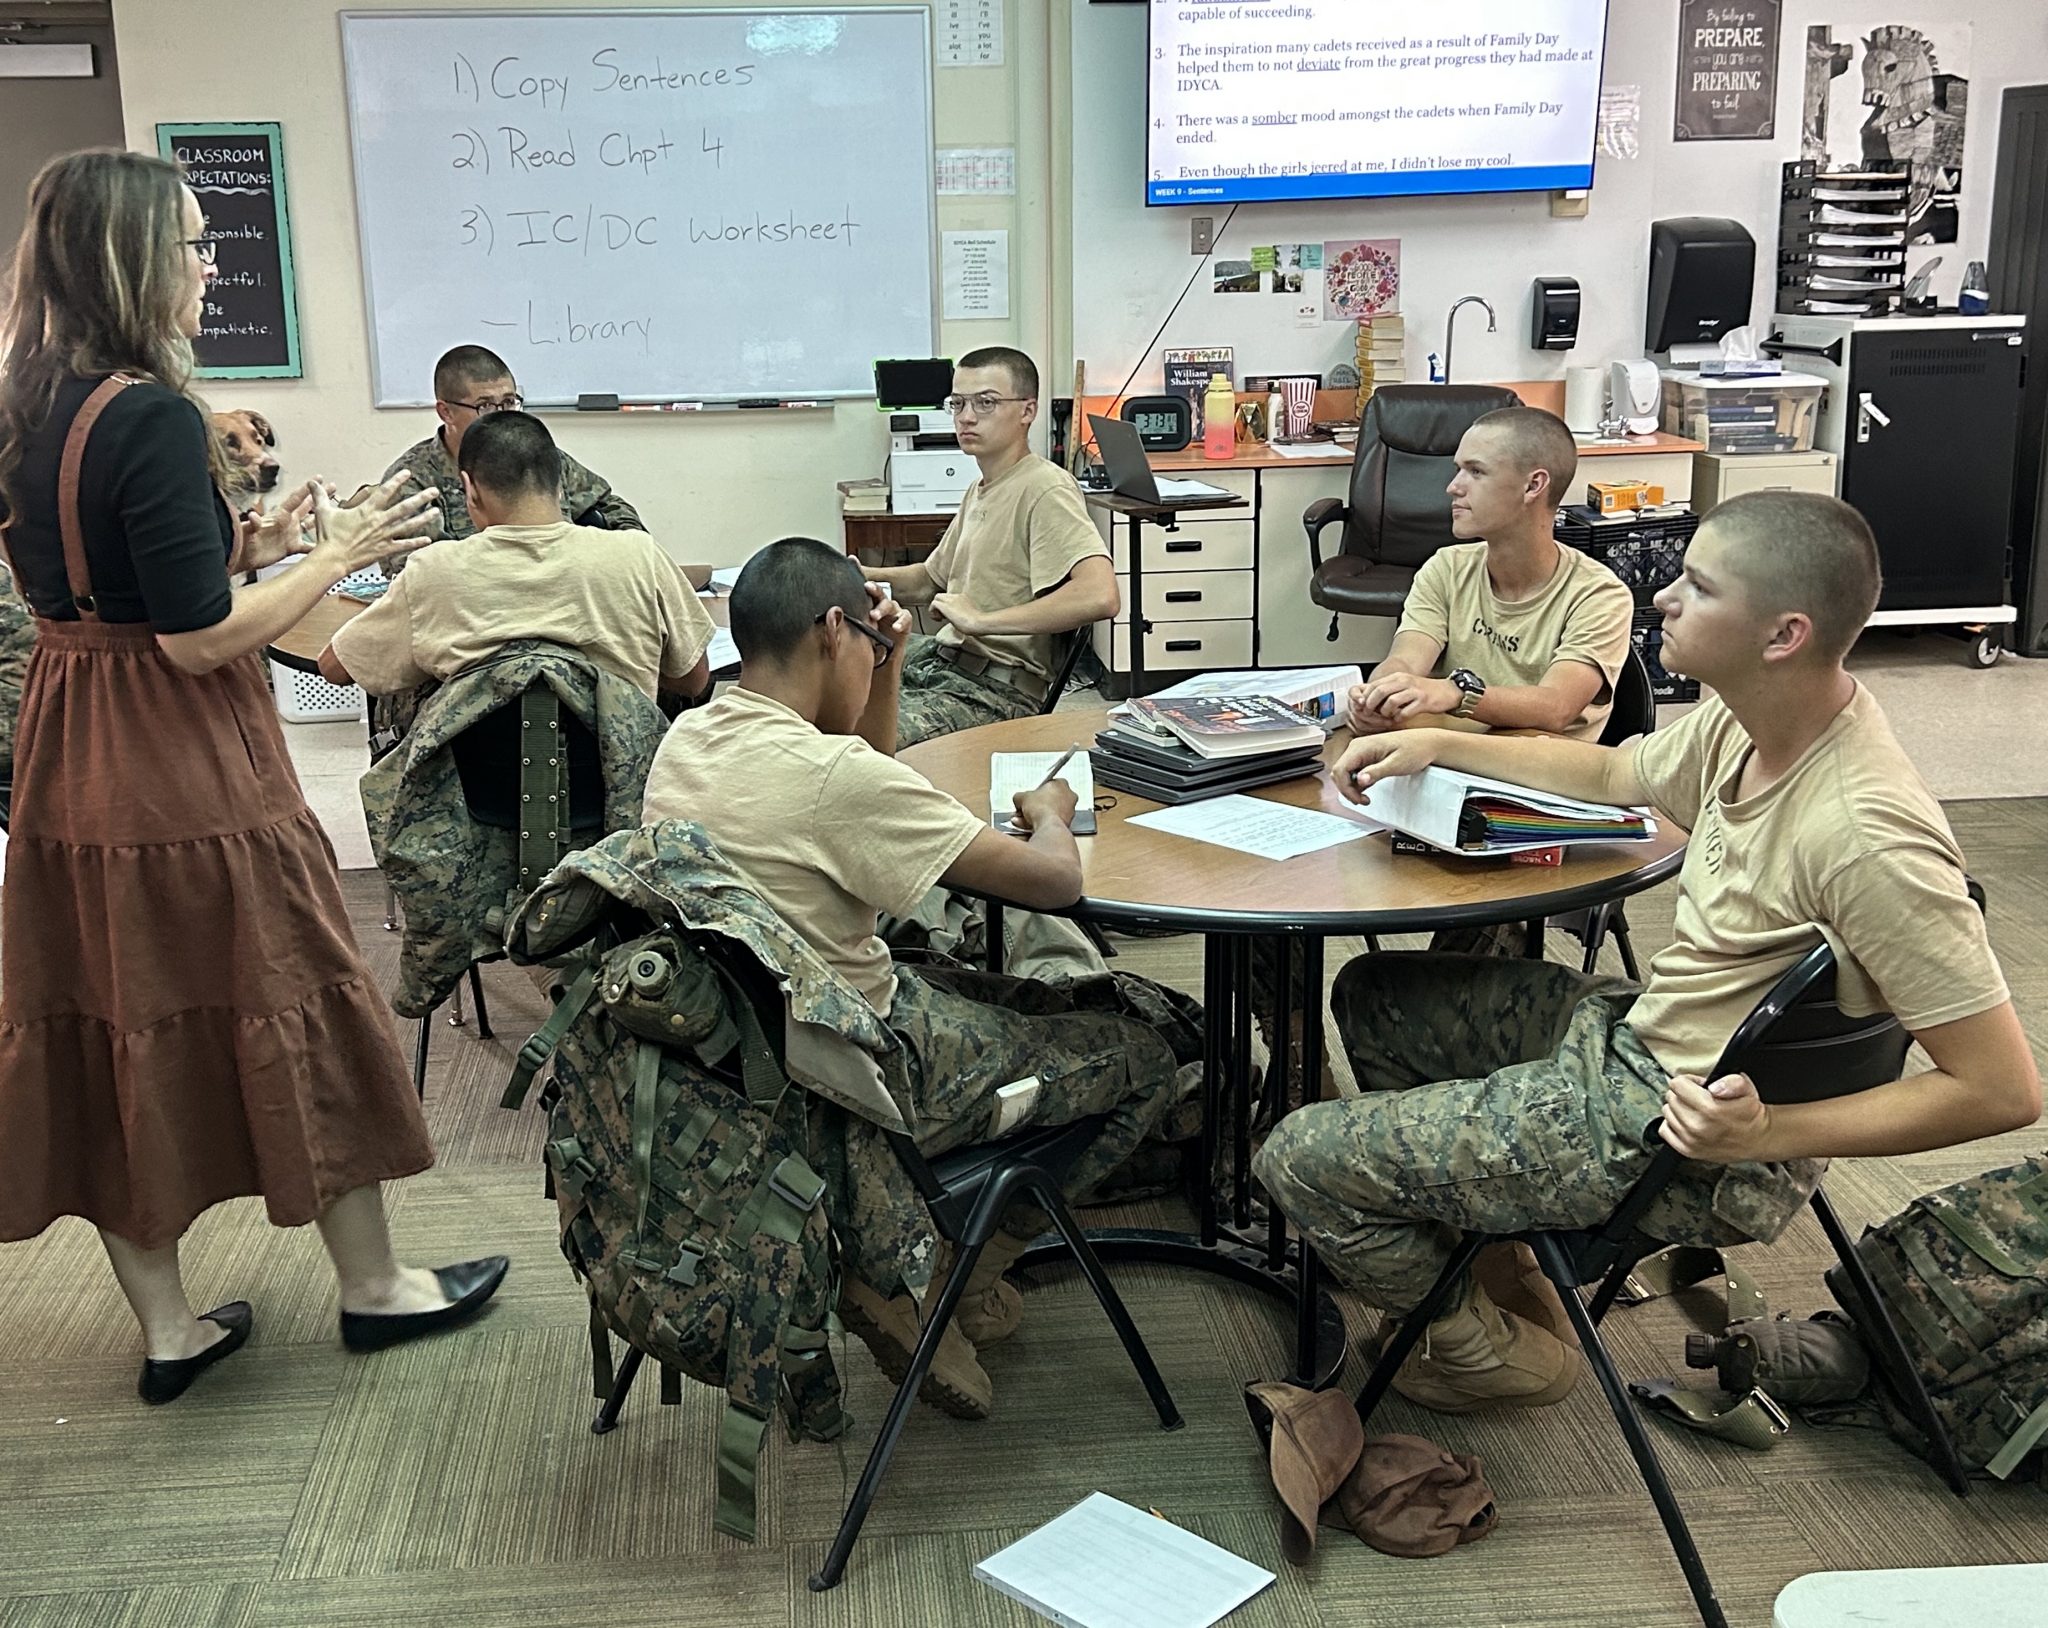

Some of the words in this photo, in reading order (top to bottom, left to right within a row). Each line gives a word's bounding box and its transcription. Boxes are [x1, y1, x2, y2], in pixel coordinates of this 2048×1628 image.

[1178, 8, 1226, 24] capable
[1229, 7, 1242, 19] of
[1244, 6, 1315, 20] succeeding.
[1706, 8, 1719, 26] By
[1747, 12, 1756, 21] to
[1154, 48, 1166, 60] 3.
[1178, 44, 1201, 57] The
[1205, 43, 1273, 60] inspiration
[1276, 42, 1310, 56] many
[1314, 38, 1352, 53] cadets
[1356, 36, 1406, 51] received
[1410, 39, 1423, 49] as
[1426, 39, 1433, 48] a
[1436, 34, 1470, 48] result
[1474, 34, 1488, 46] of
[1490, 32, 1532, 48] Family
[1535, 33, 1560, 46] Day
[1695, 27, 1766, 48] PREPARE,
[1178, 60, 1219, 76] helped
[1222, 60, 1254, 73] them
[1258, 60, 1270, 72] to
[1274, 59, 1293, 71] not
[1297, 56, 1341, 72] deviate
[1344, 56, 1374, 69] from
[1378, 54, 1397, 67] the
[1400, 54, 1430, 70] great
[1434, 54, 1486, 69] progress
[1490, 51, 1516, 65] they
[1519, 49, 1542, 63] had
[1545, 48, 1578, 62] made
[1581, 50, 1594, 61] at
[1712, 53, 1727, 70] you
[1729, 52, 1744, 65] are
[492, 56, 568, 112] Copy
[592, 48, 756, 92] Sentences
[1178, 80, 1222, 92] IDYCA.
[1692, 70, 1762, 92] PREPARING
[1711, 97, 1722, 109] to
[1154, 118, 1165, 130] 4.
[1176, 114, 1212, 127] There
[1215, 116, 1239, 126] was
[1242, 116, 1248, 125] a
[1252, 111, 1298, 125] somber
[1301, 109, 1335, 122] mood
[1338, 108, 1390, 123] amongst
[1394, 106, 1414, 119] the
[1417, 104, 1455, 118] cadets
[1458, 104, 1490, 116] when
[1494, 102, 1536, 118] Family
[1539, 102, 1564, 116] Day
[1176, 130, 1216, 144] ended.
[176, 147, 264, 164] CLASSROOM
[498, 126, 576, 173] Read
[600, 128, 674, 176] Chpt
[702, 127, 724, 169] 4
[1154, 169, 1164, 182] 5.
[1180, 166, 1209, 178] Even
[1213, 164, 1255, 180] though
[1258, 163, 1278, 176] the
[1281, 162, 1307, 177] girls
[1310, 160, 1347, 176] jeered
[1351, 160, 1362, 172] at
[1366, 161, 1388, 172] me,
[1392, 158, 1396, 170] I
[1400, 156, 1434, 170] didn't
[1438, 156, 1462, 168] lose
[1465, 158, 1484, 170] my
[1487, 153, 1514, 166] cool.
[185, 170, 272, 184] XPECTATIONS:
[1155, 188, 1176, 196] WEEK
[1188, 186, 1224, 196] Sentences
[506, 203, 658, 256] IC/DC
[690, 204, 860, 248] Worksheet
[206, 302, 224, 316] Be
[528, 300, 652, 359] Library
[1174, 369, 1208, 378] William
[1170, 378, 1210, 388] Shakespe
